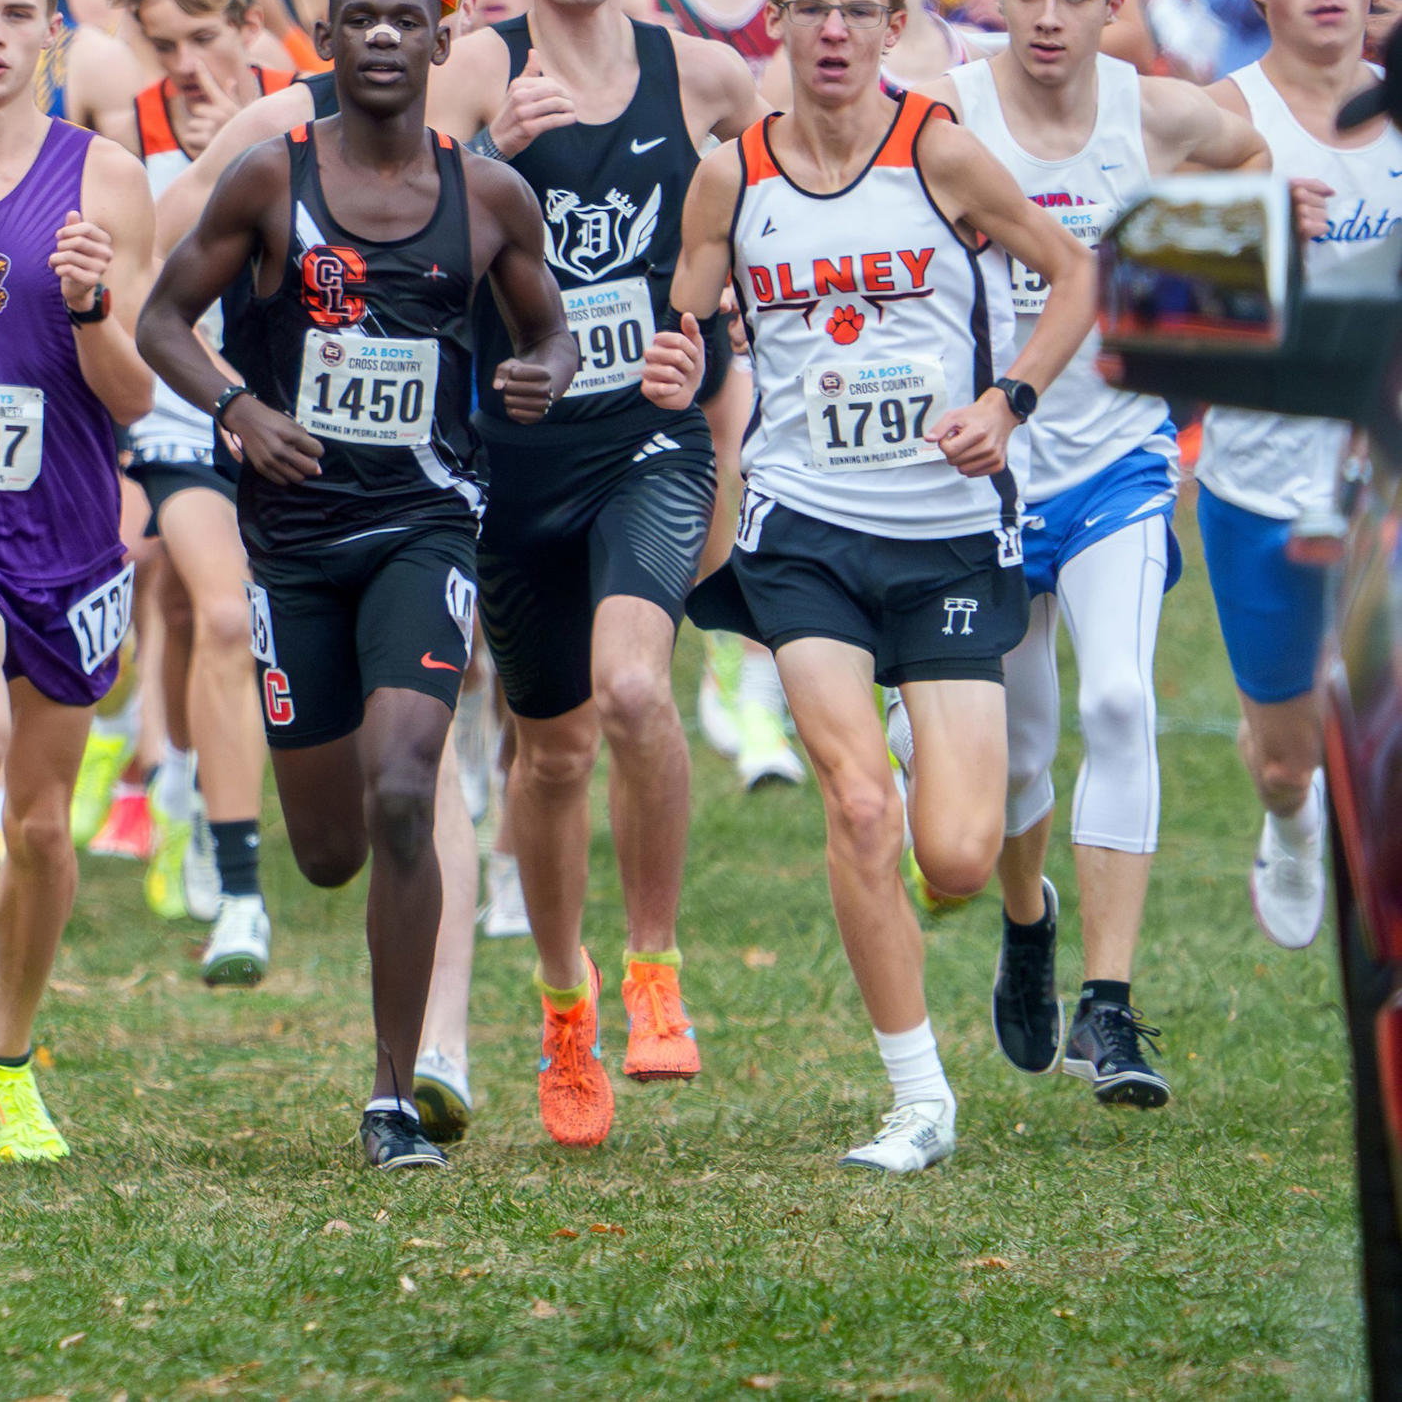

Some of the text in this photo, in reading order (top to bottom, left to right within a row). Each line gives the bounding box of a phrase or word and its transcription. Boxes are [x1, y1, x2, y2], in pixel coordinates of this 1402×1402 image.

[1062, 214, 1092, 225] BOYS
[1069, 226, 1101, 238] OUNTRY
[748, 247, 936, 304] OLNEY
[568, 291, 621, 309] 2A BOYS
[567, 301, 632, 321] ROSS COUNTRY
[361, 346, 414, 359] 2A BOYS
[348, 357, 422, 373] CROSS COUNTRY
[859, 365, 913, 380] 2A BOYS
[849, 376, 925, 396] CROSS COUNTRY
[312, 372, 425, 424] 1450
[311, 420, 342, 434] RUNNING
[352, 425, 378, 438] PEORIA
[378, 428, 398, 440] 2025
[822, 394, 934, 449] 1797
[829, 455, 861, 466] RUNNING
[898, 448, 918, 459] 2025
